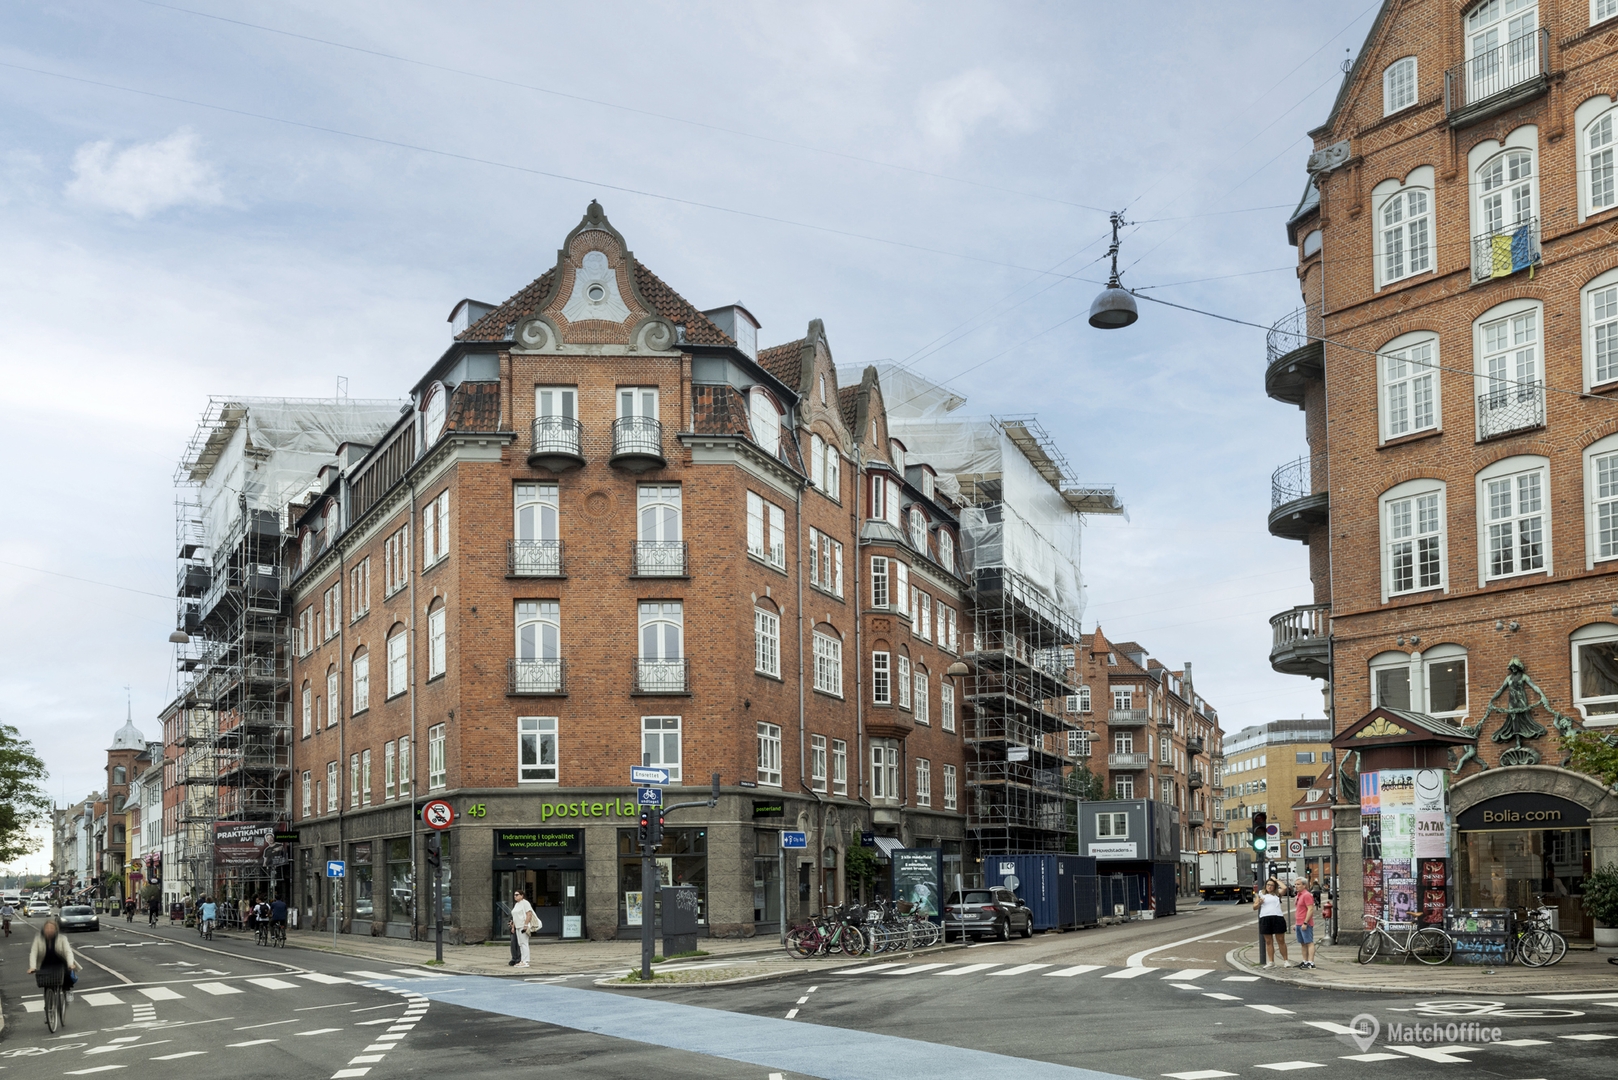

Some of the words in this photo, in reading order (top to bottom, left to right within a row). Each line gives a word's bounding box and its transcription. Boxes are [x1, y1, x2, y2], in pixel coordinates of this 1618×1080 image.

[635, 771, 660, 779] Ensrettet
[467, 803, 487, 818] 45
[541, 798, 663, 821] posterla
[1418, 820, 1429, 831] JA
[1430, 820, 1445, 831] TAK
[217, 827, 273, 839] PRAKTIKANTER
[502, 833, 537, 841] Indramning
[541, 833, 575, 841] topkvalitet
[1389, 923, 1418, 931] CINEMATEET
